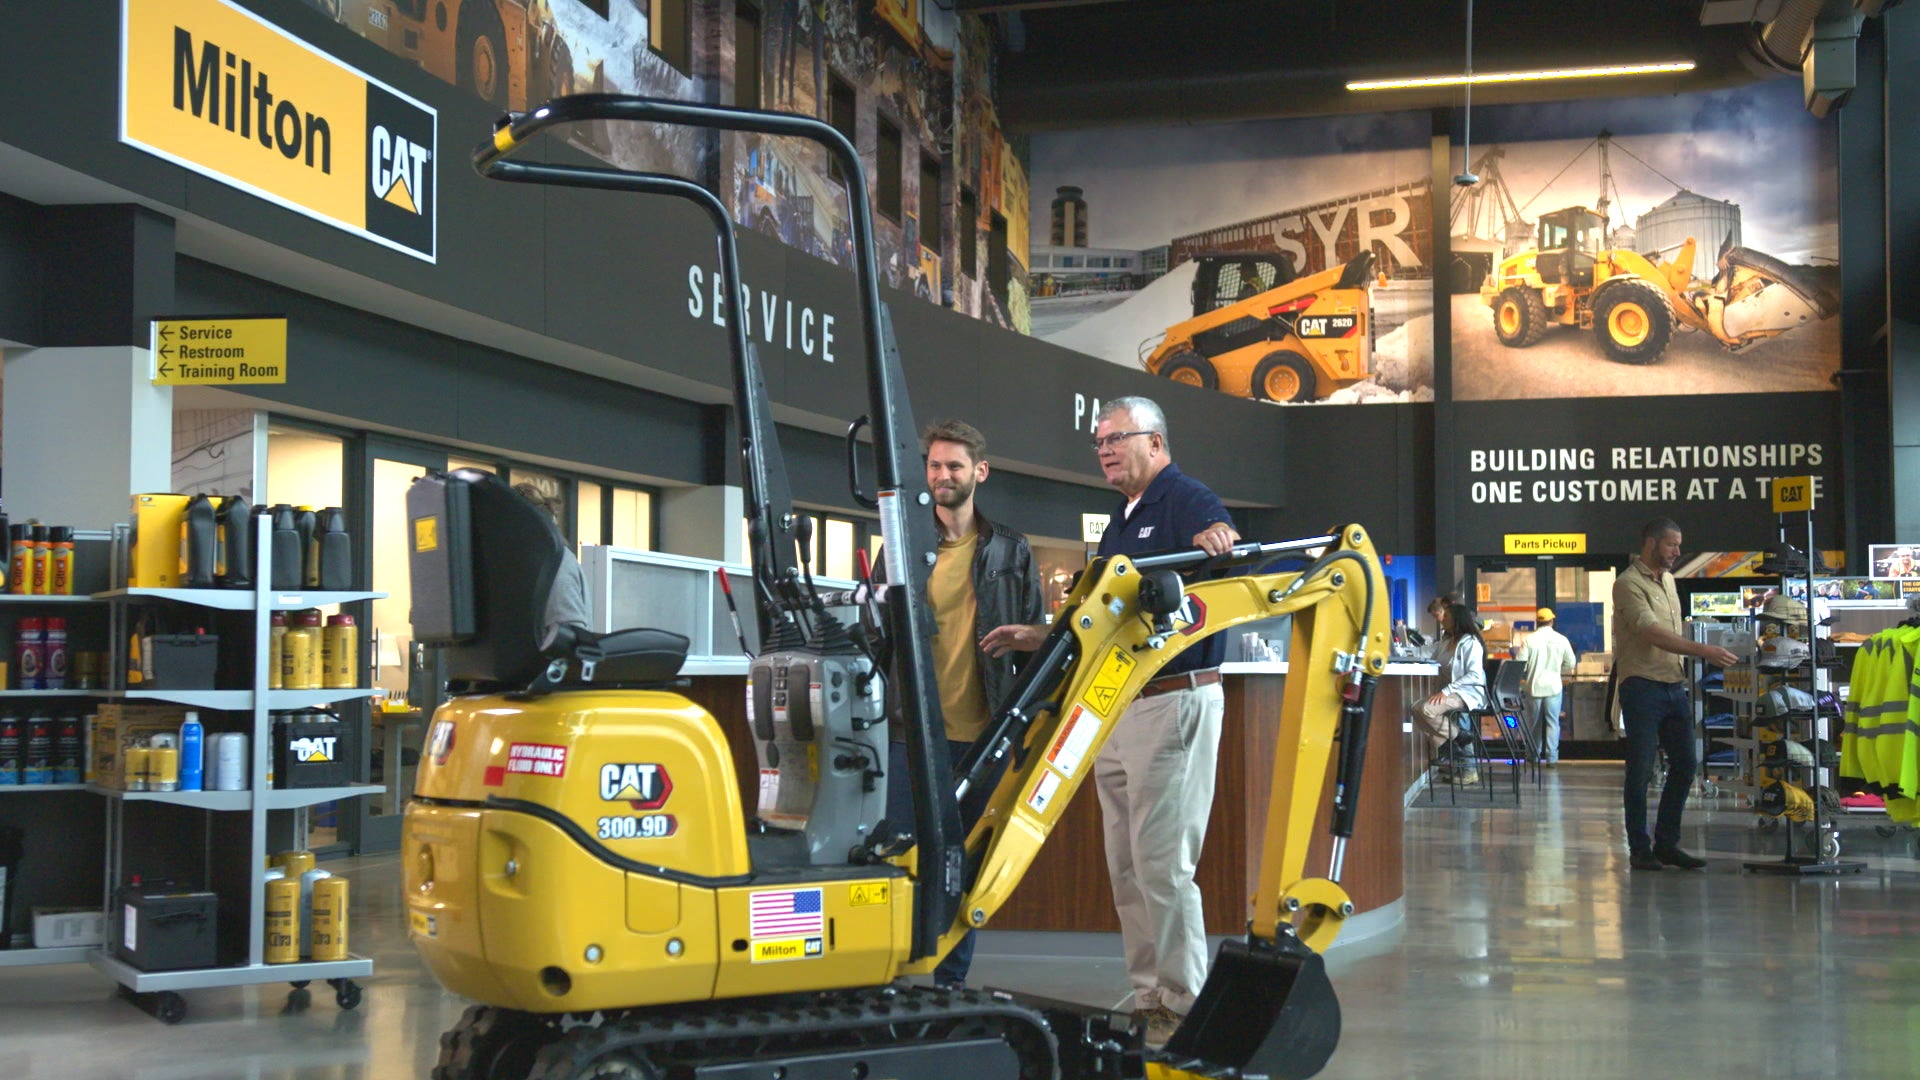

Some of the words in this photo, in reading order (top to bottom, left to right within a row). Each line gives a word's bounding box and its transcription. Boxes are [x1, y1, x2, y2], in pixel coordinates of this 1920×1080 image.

[173, 25, 331, 175] Milton
[372, 125, 427, 215] CAT
[1274, 195, 1422, 273] SYR
[180, 325, 232, 340] Service
[1301, 318, 1328, 335] CAT
[180, 345, 244, 359] Restroom
[179, 364, 234, 380] Training
[239, 363, 278, 377] Room
[1470, 448, 1595, 472] BUILDING
[1611, 444, 1823, 469] RELATIONSHIPS
[1471, 481, 1522, 503] ONE
[1532, 479, 1677, 502] CUSTOMER
[1686, 478, 1719, 500] AT
[1728, 477, 1747, 499] A
[1755, 476, 1823, 499] TE
[1780, 485, 1803, 502] CAT
[1089, 521, 1105, 535] CAT
[1138, 526, 1155, 538] CAT
[1514, 540, 1540, 548] Parts
[1542, 539, 1577, 550] Pickup
[1169, 595, 1195, 625] AT
[297, 737, 337, 762] CAT
[510, 745, 565, 761] HYDRAULIC
[507, 759, 532, 772] FLUID
[534, 761, 563, 775] ONLY
[601, 763, 657, 800] CAT
[598, 815, 668, 838] 300.9D
[762, 946, 797, 957] Milton
[805, 941, 820, 953] CAT
